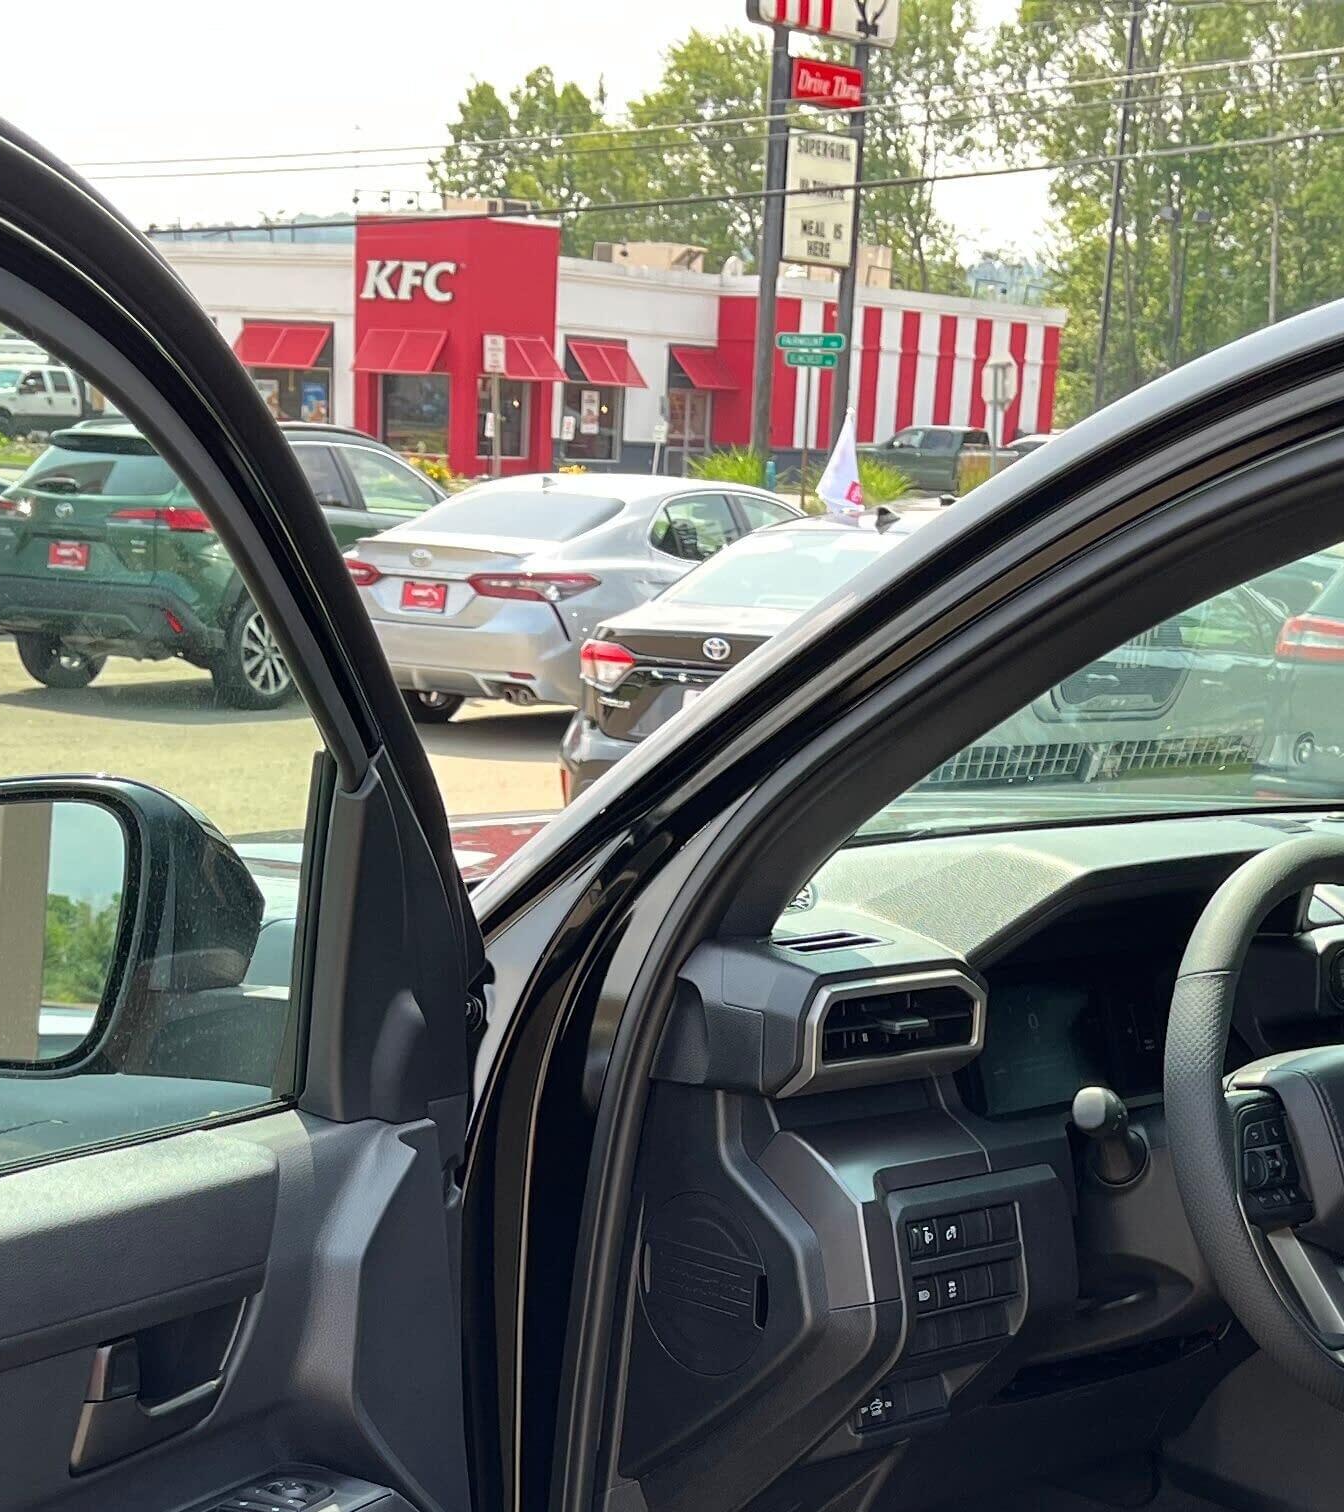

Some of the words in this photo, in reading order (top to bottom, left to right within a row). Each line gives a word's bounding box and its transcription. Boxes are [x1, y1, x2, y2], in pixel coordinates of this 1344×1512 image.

[798, 67, 831, 97] Drive
[832, 75, 861, 102] Thru
[801, 219, 825, 238] MEAL
[833, 223, 843, 240] IS
[807, 240, 830, 259] HERE
[359, 259, 457, 303] KFC
